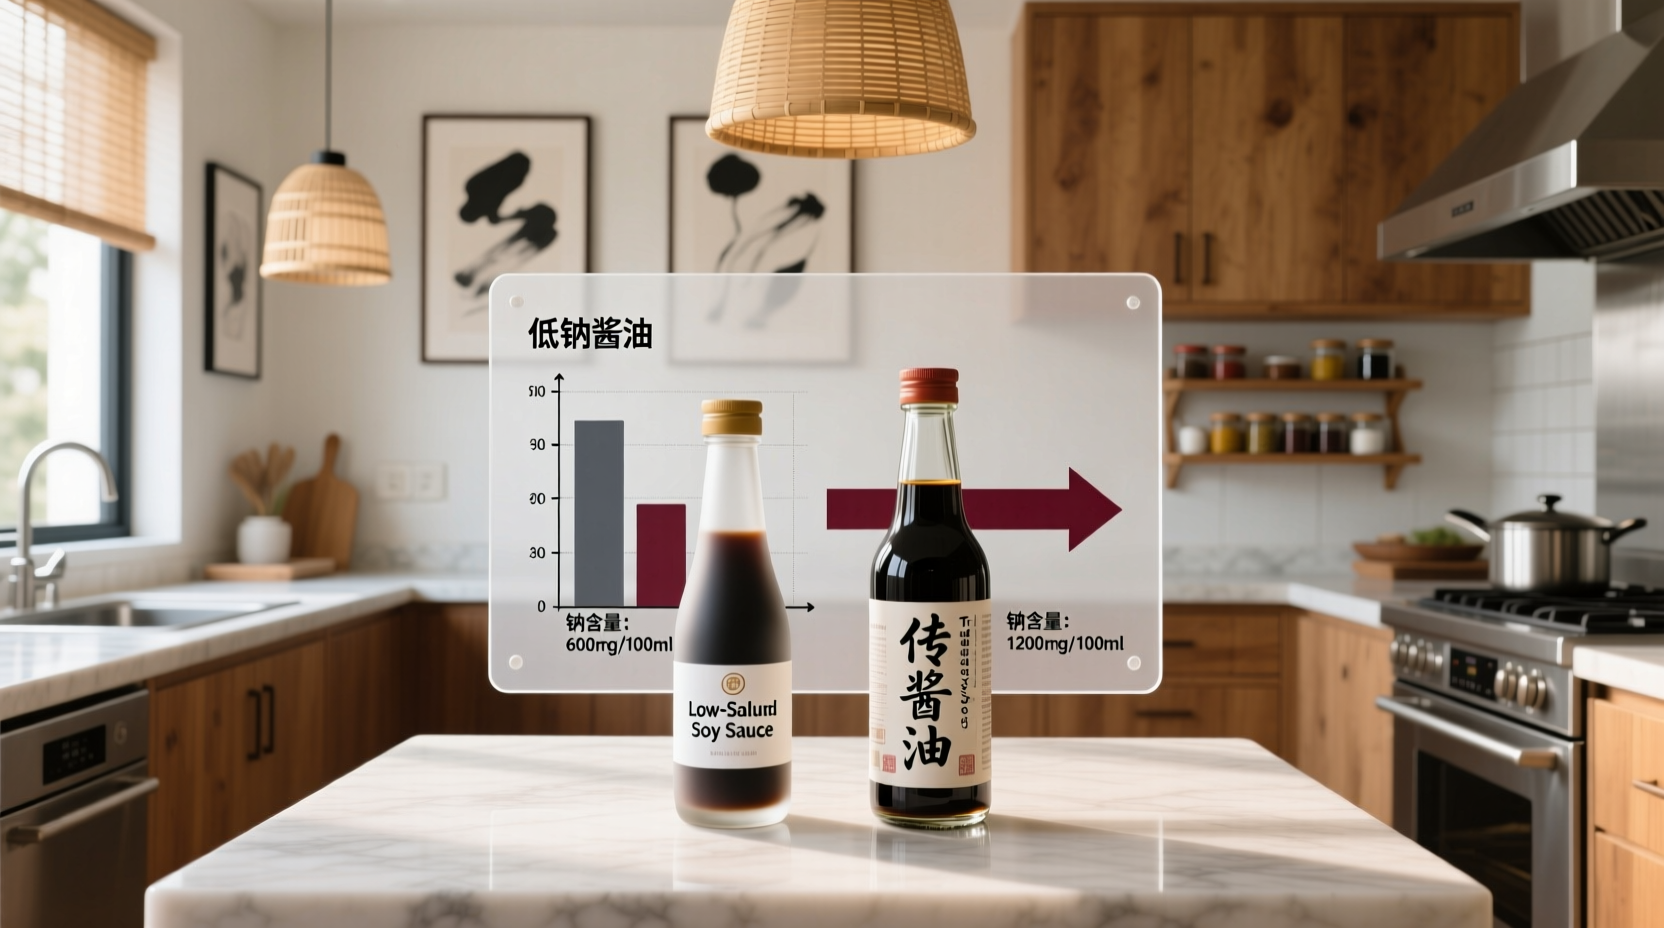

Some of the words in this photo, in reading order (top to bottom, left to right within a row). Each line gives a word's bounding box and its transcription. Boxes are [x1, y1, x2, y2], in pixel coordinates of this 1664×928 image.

[528, 316, 653, 350] 低钠酱油
[537, 599, 546, 613] 0
[565, 635, 673, 657] 600mg/100ml
[1006, 635, 1125, 655] 1200mg/100ml
[691, 721, 721, 743] Soy
[725, 721, 774, 739] Sauce
